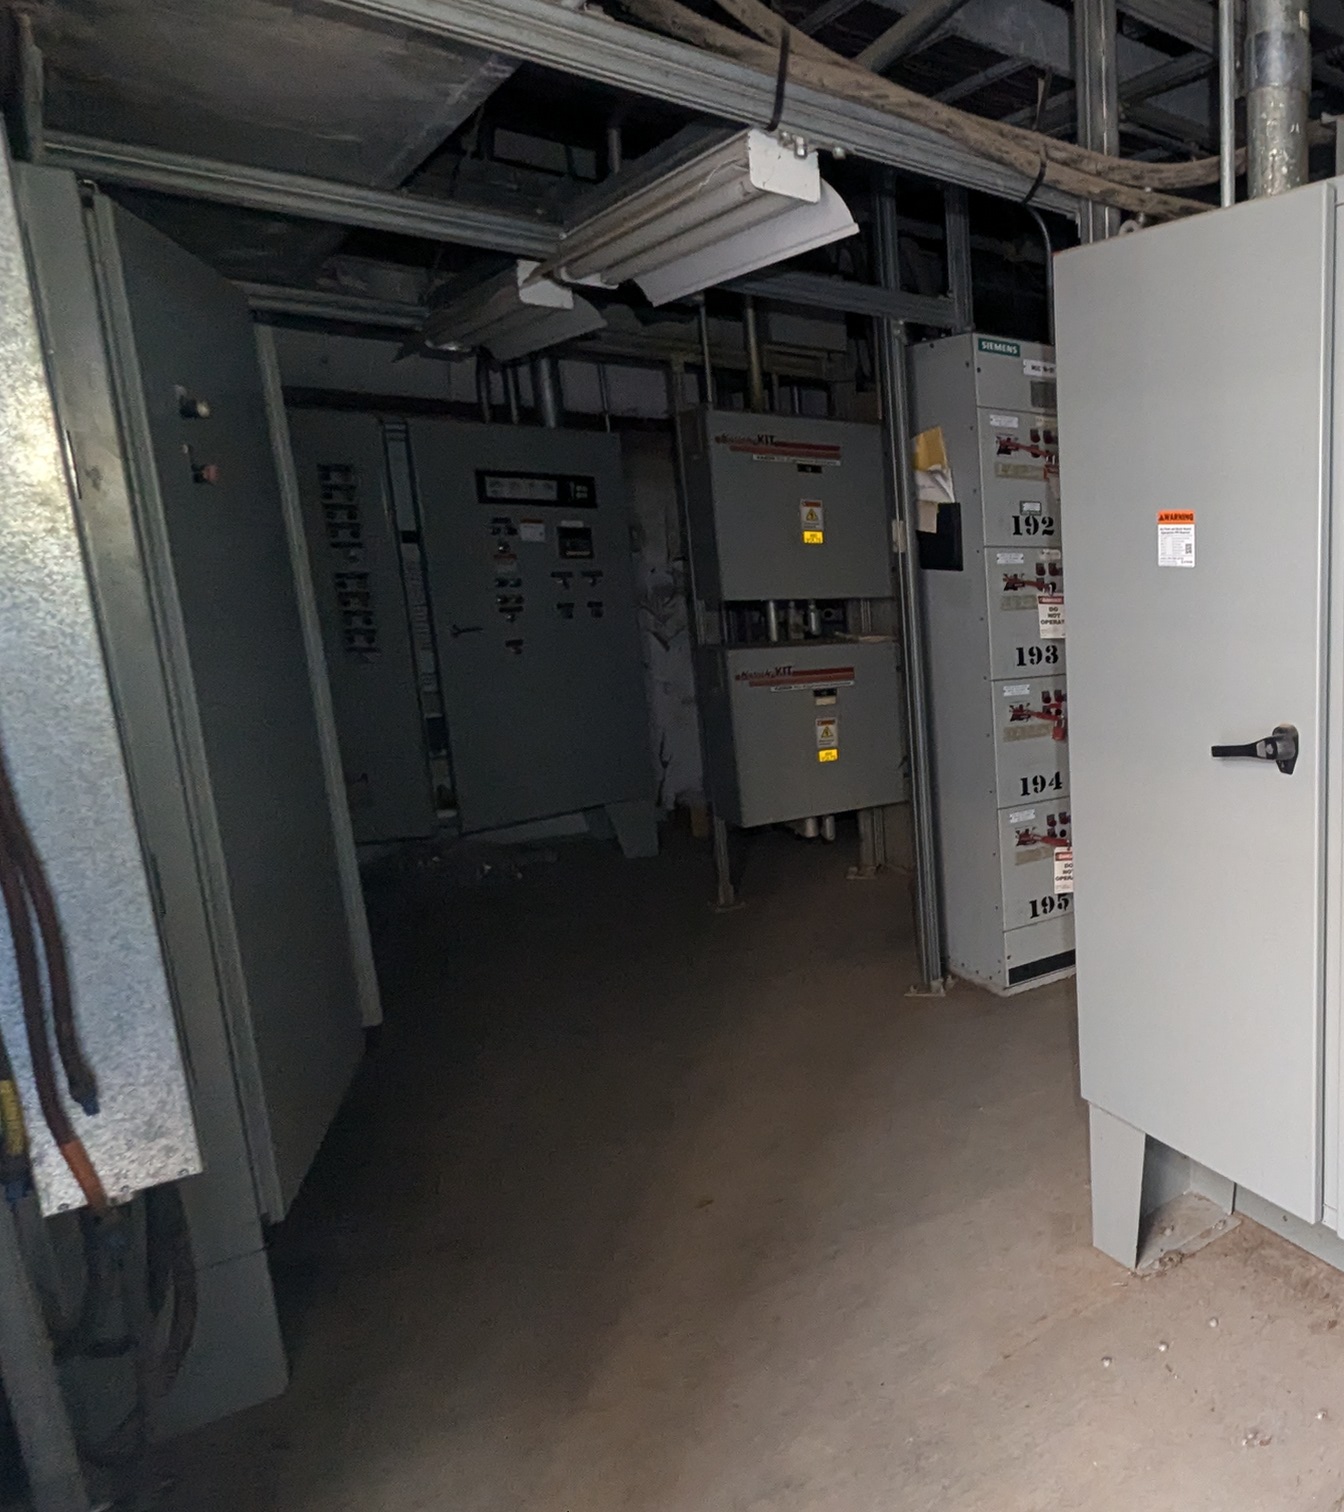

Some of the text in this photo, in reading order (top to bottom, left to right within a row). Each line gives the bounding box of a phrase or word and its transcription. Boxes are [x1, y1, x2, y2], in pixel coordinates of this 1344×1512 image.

[982, 341, 1018, 354] SIEMENS
[1012, 515, 1055, 536] 192
[1164, 513, 1193, 521] WARNING
[1016, 645, 1059, 666] 193
[1021, 771, 1062, 796] 194
[1029, 893, 1069, 919] 195
